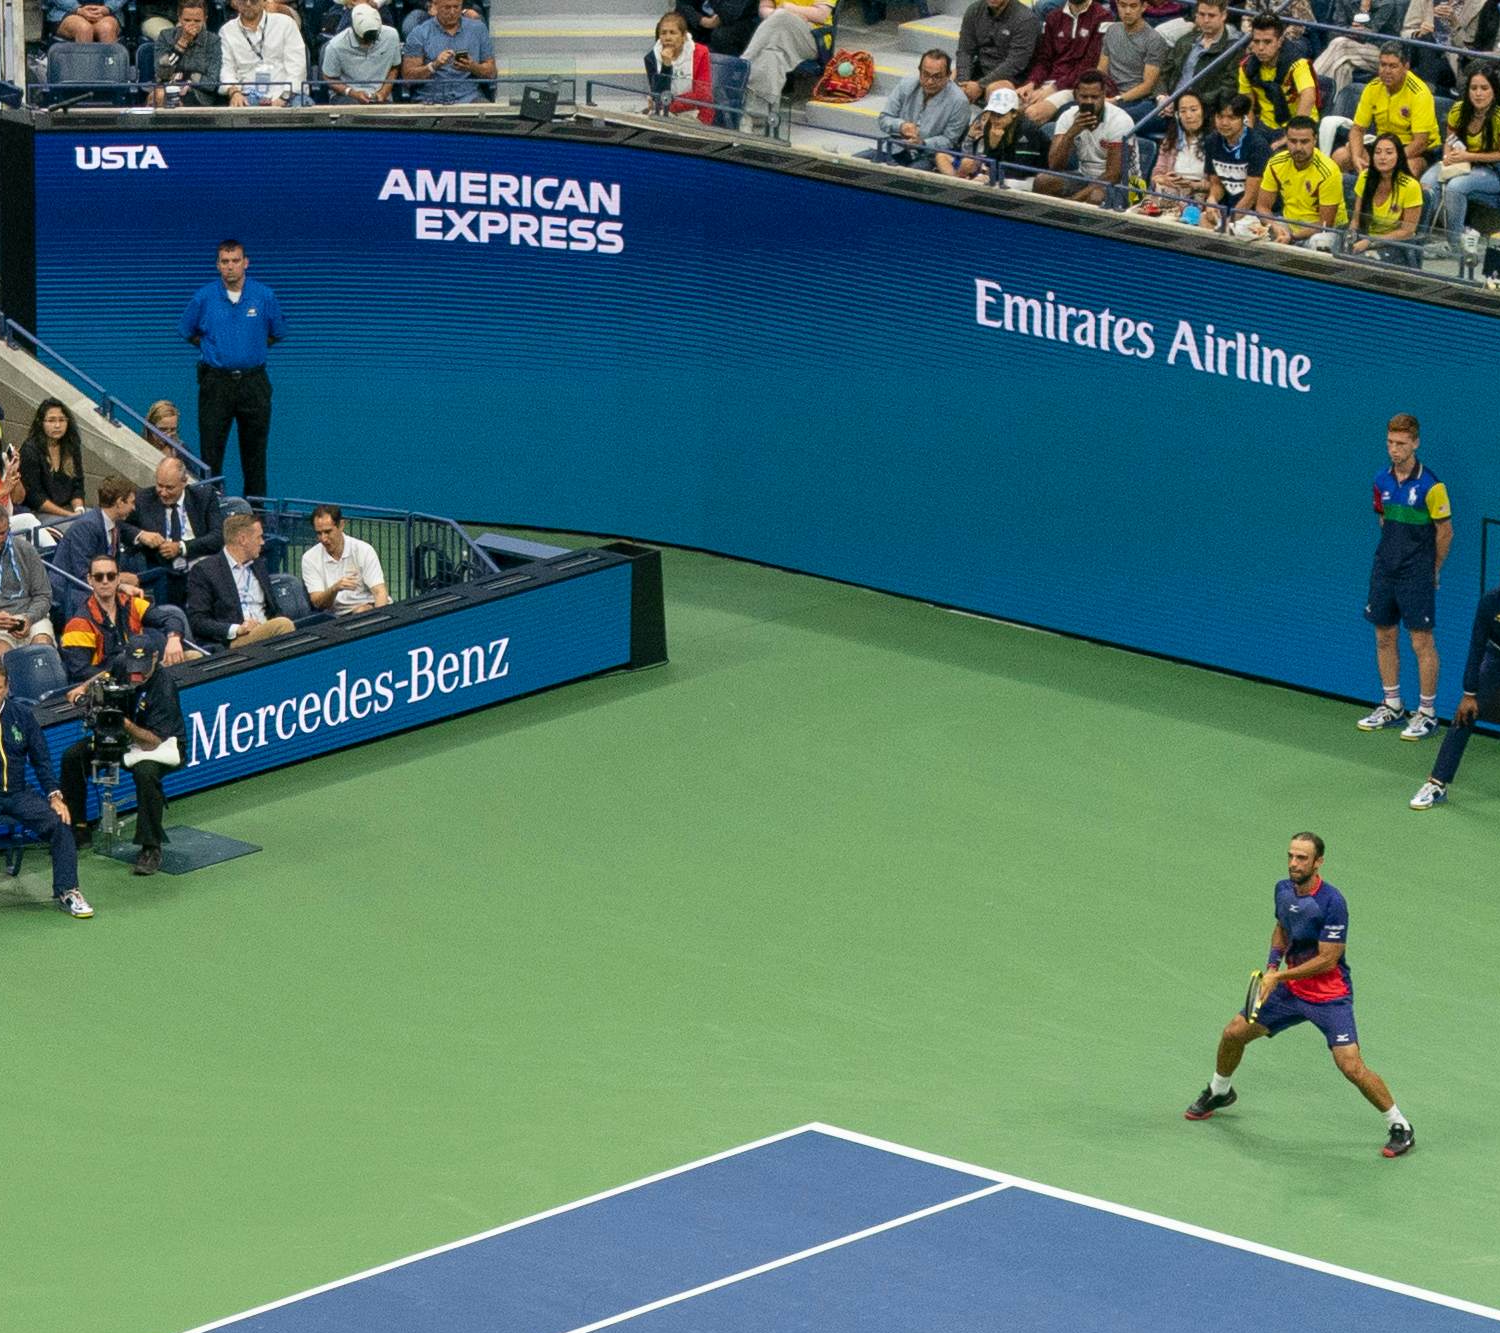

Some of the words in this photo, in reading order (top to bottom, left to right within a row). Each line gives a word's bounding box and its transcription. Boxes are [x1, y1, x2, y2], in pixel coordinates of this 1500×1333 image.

[74, 144, 169, 171] USTA
[378, 168, 622, 216] AMERICAN
[415, 207, 625, 255] EXPRESS
[974, 277, 1156, 360] Emirates
[1167, 319, 1312, 393] Airline
[186, 636, 510, 768] Mercedes-Benz
